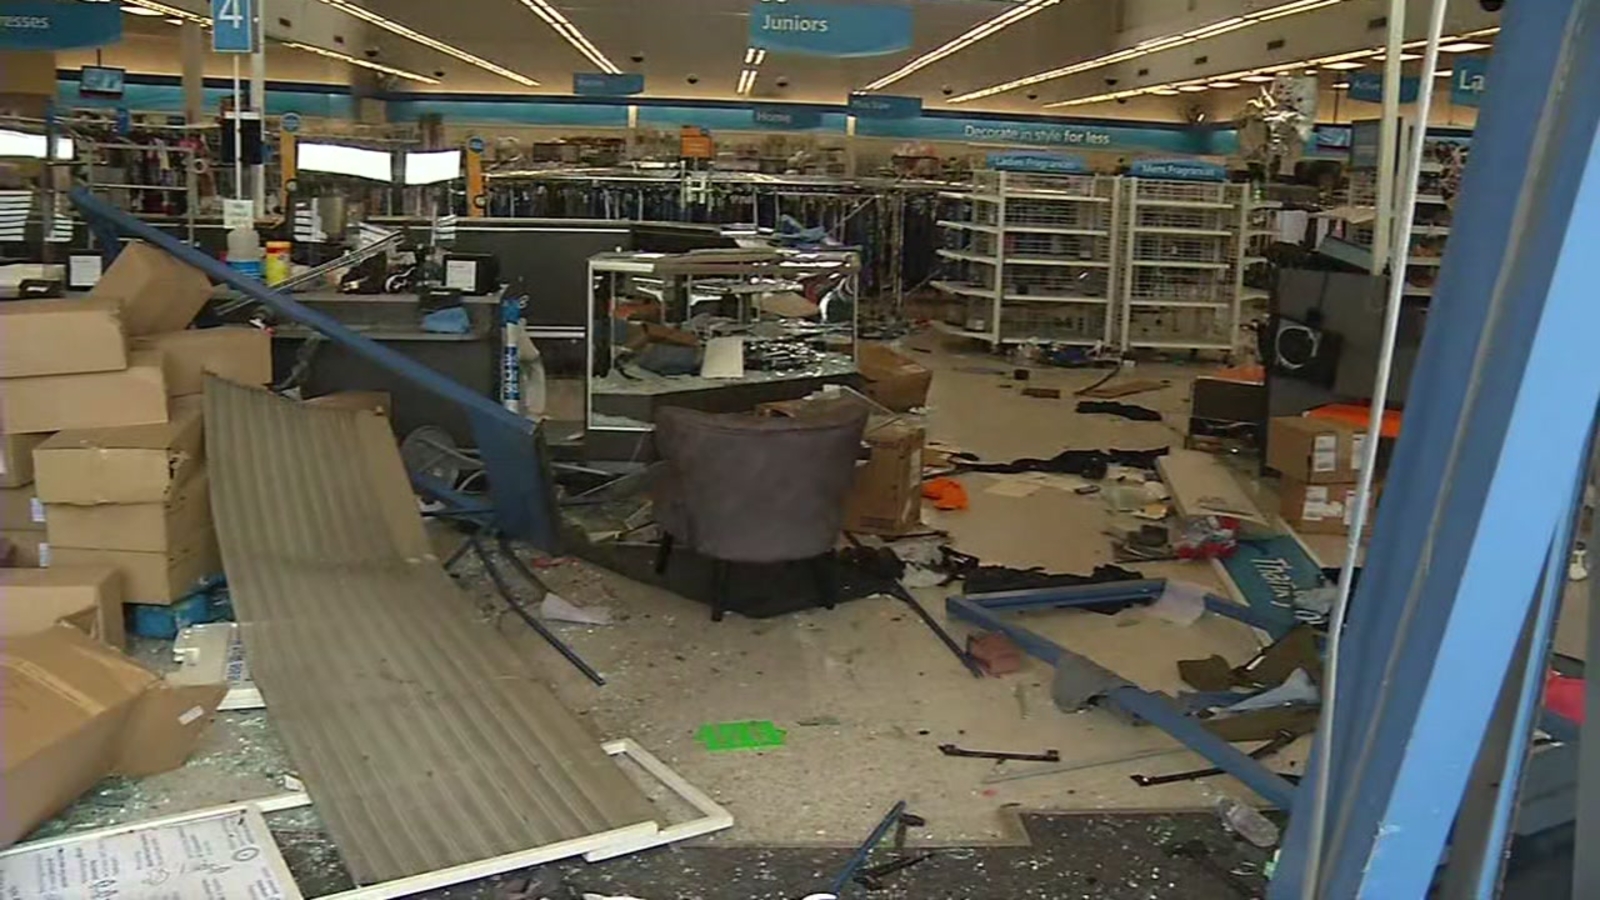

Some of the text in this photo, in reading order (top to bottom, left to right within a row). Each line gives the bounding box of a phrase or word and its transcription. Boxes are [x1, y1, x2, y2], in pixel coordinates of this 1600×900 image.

[219, 0, 243, 28] 4
[762, 15, 828, 32] Juniors
[756, 111, 791, 123] Home
[964, 124, 1018, 140] Decorate
[1034, 130, 1061, 144] style
[1063, 130, 1083, 143] for
[1086, 131, 1110, 145] less
